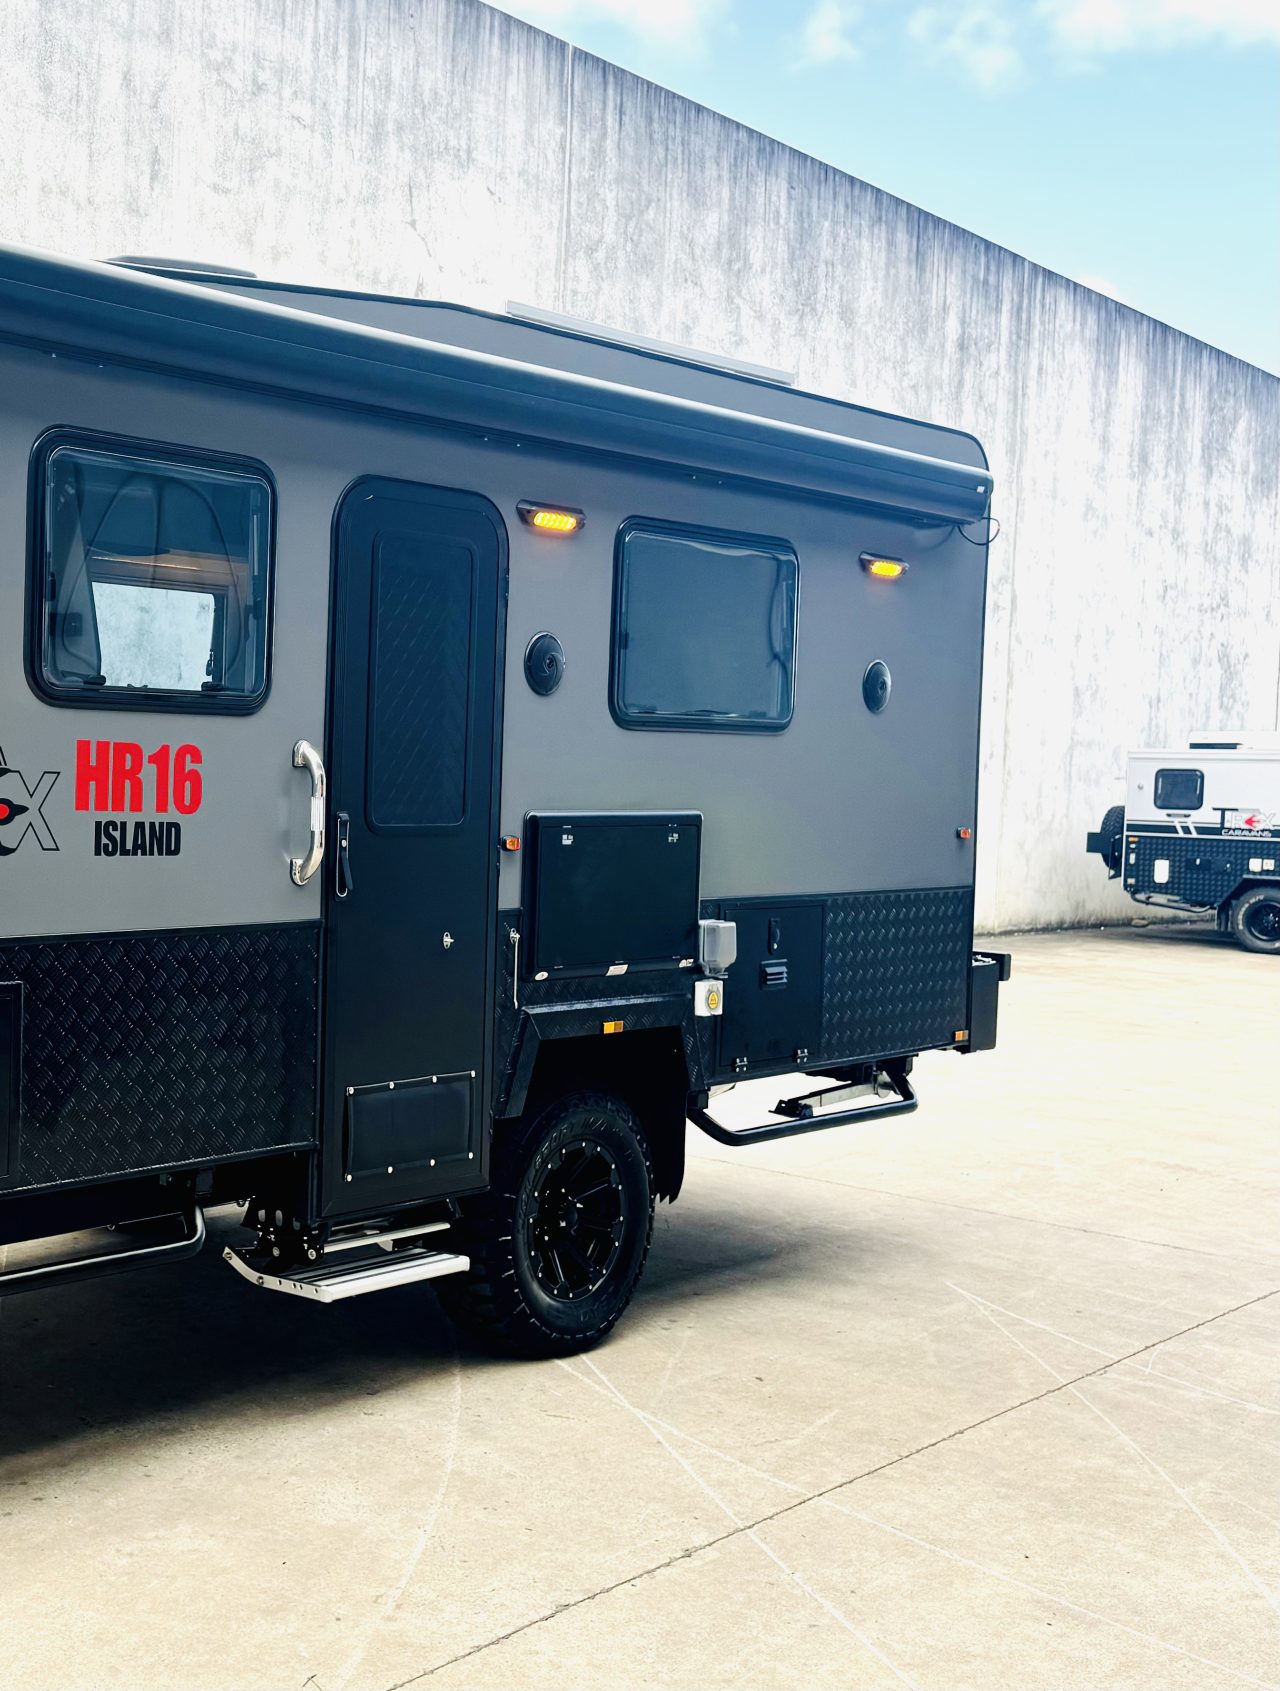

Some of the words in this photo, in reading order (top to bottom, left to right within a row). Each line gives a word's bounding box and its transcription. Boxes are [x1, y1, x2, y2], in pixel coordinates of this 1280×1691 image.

[74, 739, 203, 815] HR16
[94, 819, 182, 857] ISLAND
[1221, 829, 1272, 838] CARAVANS
